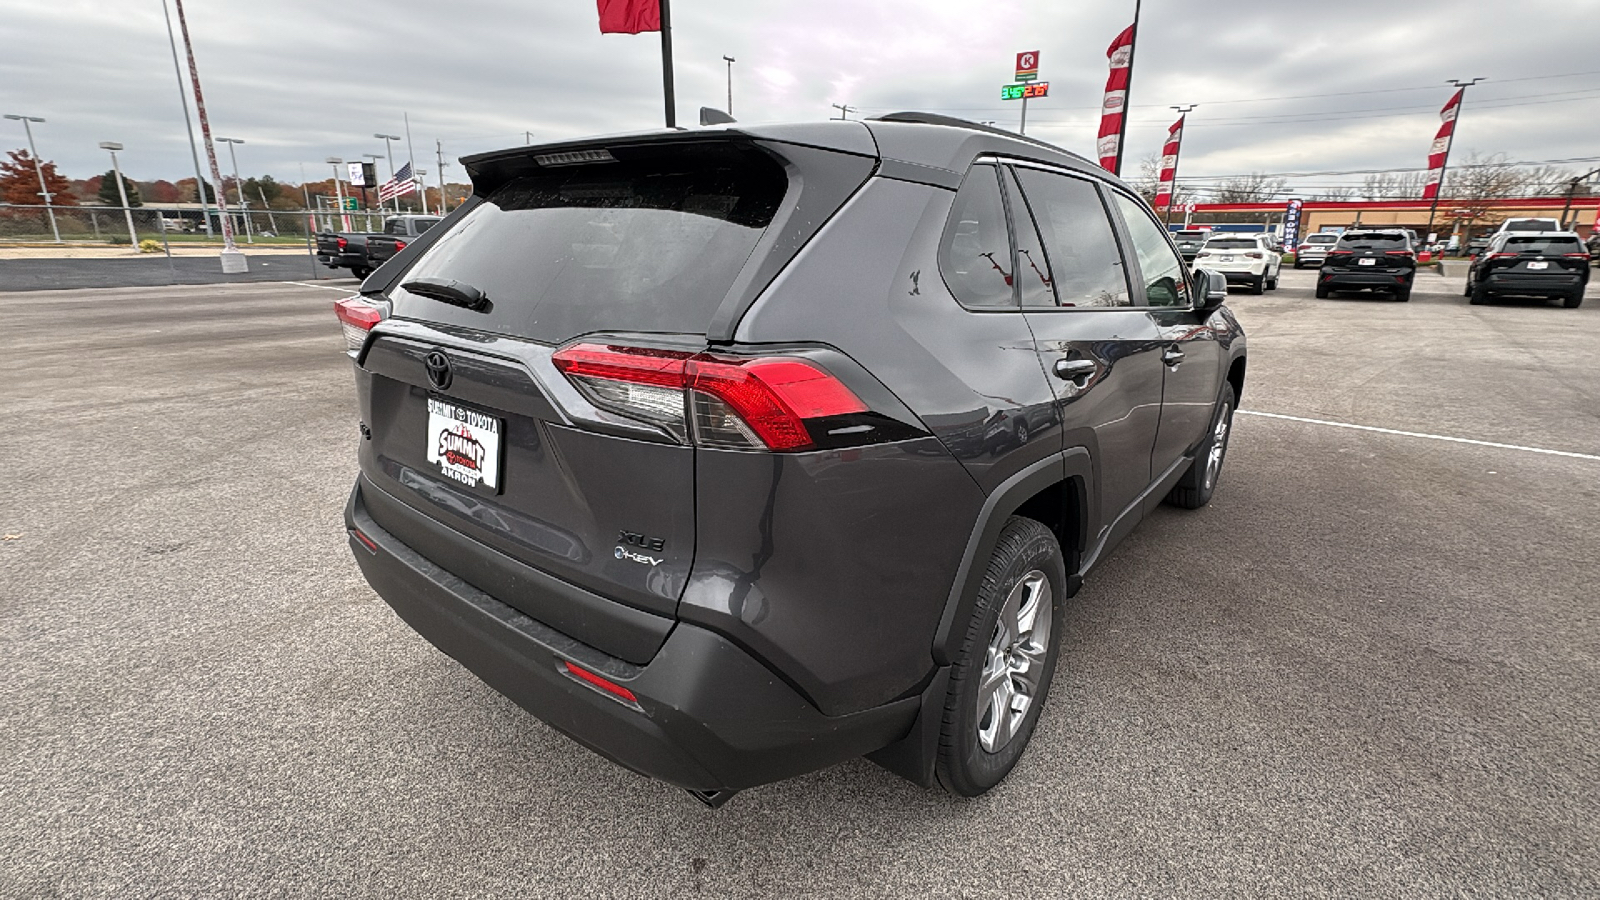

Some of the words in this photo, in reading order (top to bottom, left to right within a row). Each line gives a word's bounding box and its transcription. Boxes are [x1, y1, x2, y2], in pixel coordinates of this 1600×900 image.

[428, 399, 456, 420] SUMMIT
[467, 410, 498, 434] TOYOTA
[439, 430, 485, 470] SUMMIT
[456, 455, 477, 469] TOYOTA
[441, 467, 476, 488] AKRON
[617, 529, 666, 553] XLE
